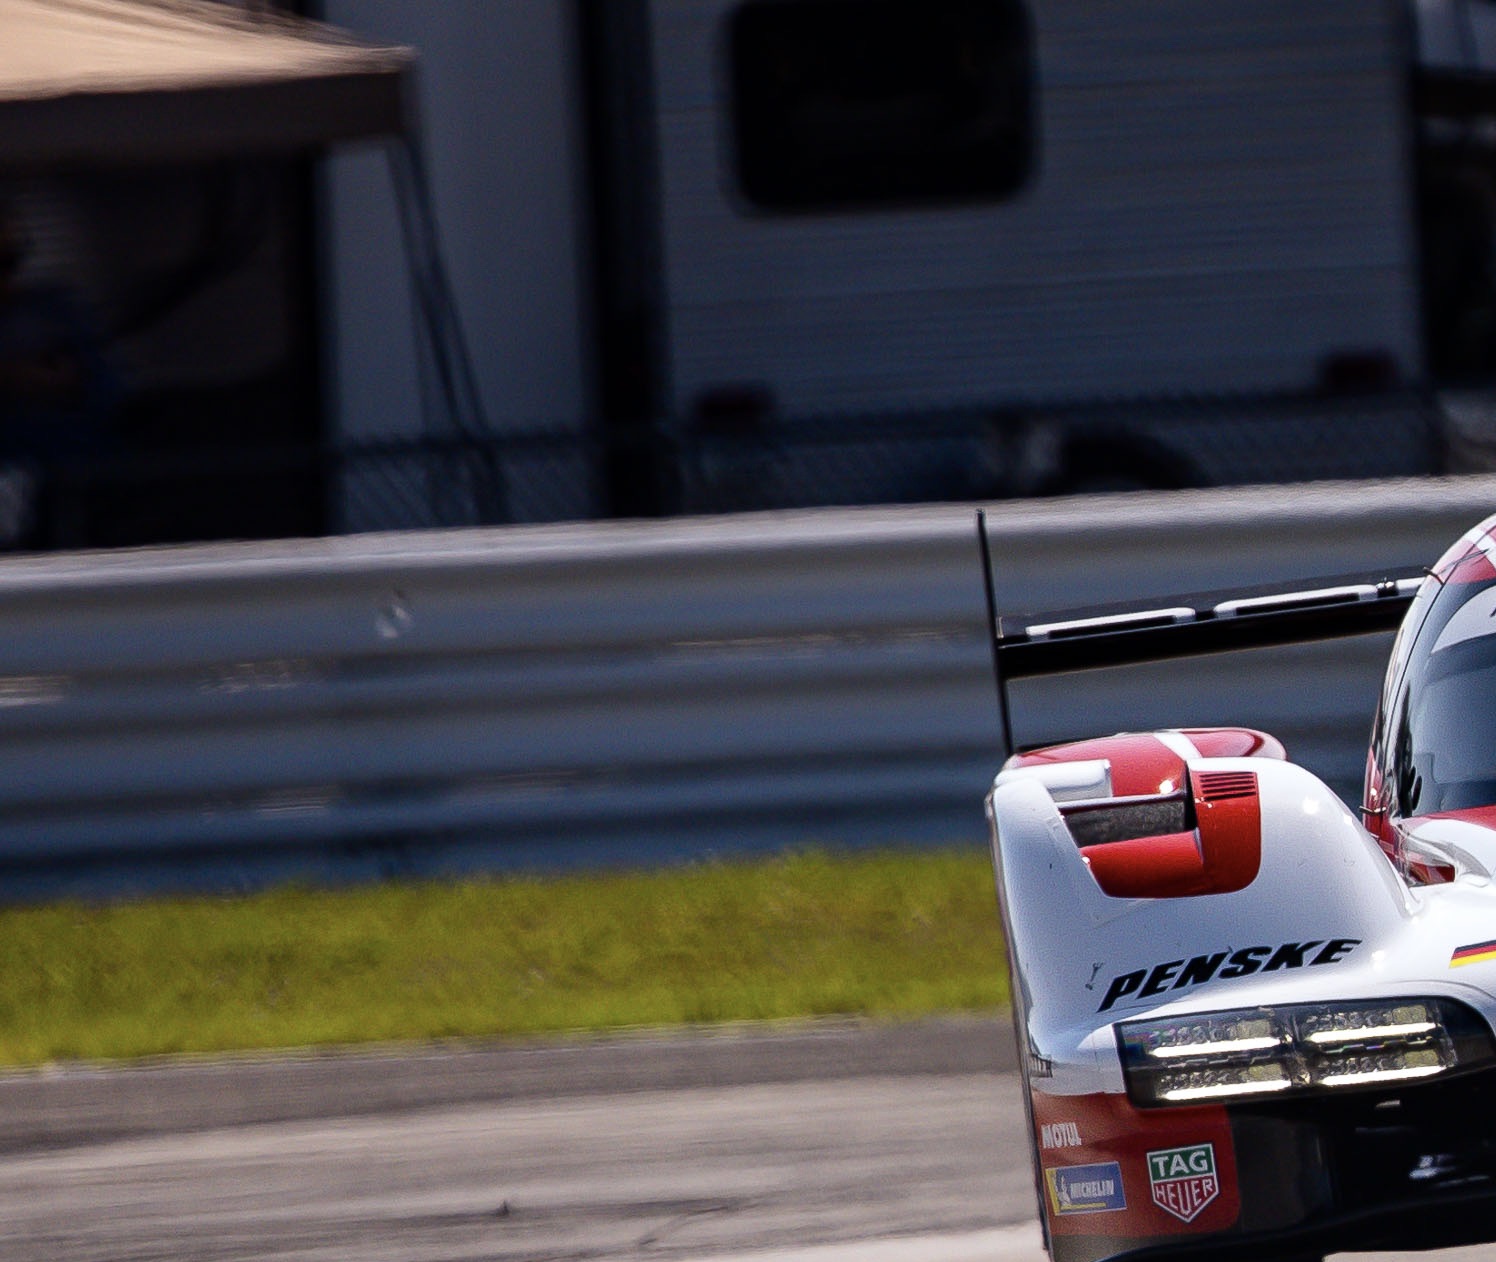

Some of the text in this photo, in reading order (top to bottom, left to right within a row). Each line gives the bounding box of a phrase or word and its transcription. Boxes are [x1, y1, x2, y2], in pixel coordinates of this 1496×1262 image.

[1095, 938, 1363, 1014] PENSKE
[1041, 1121, 1082, 1149] MOTUL
[1152, 1150, 1209, 1178] TAG
[1070, 1178, 1115, 1199] MICHELIN
[1155, 1179, 1213, 1216] HEUER
